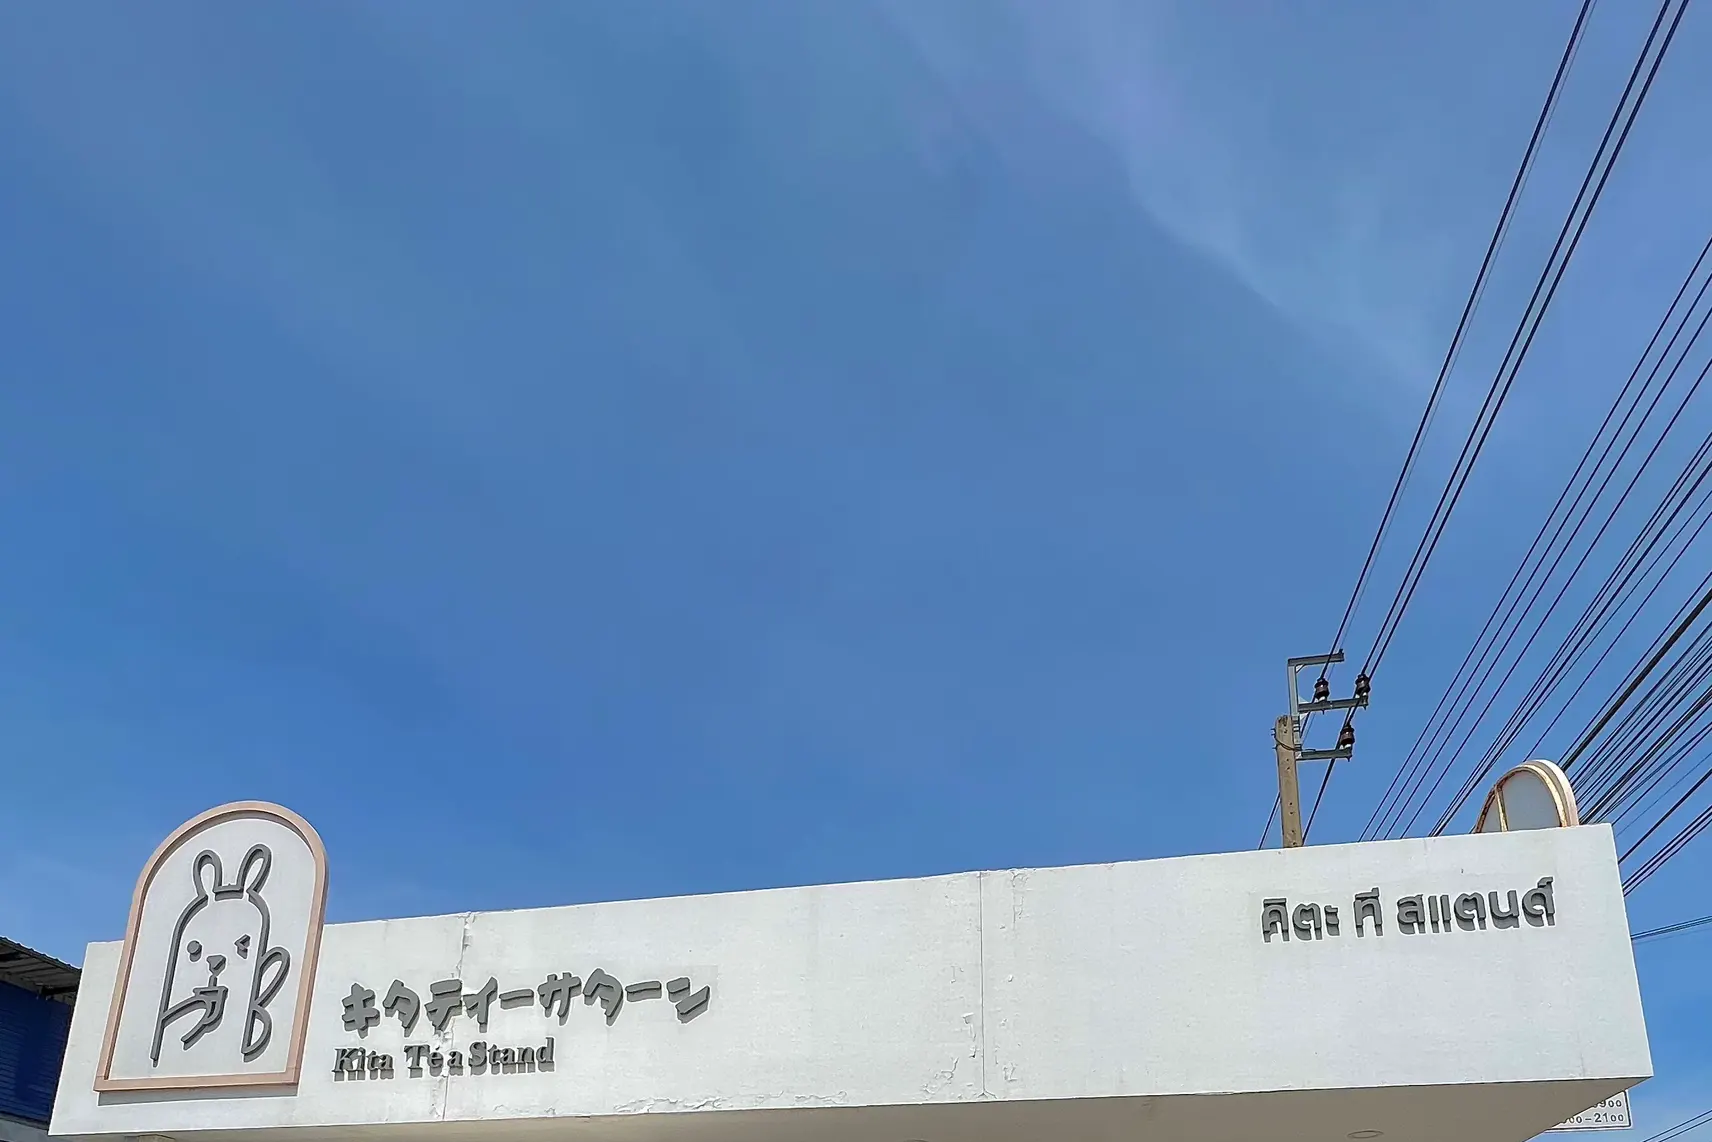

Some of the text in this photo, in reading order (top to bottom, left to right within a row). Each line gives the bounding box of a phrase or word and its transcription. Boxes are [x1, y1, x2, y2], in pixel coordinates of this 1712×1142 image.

[1396, 876, 1556, 936] สแตนด์
[331, 1036, 555, 1082] Kita Tea Stand
